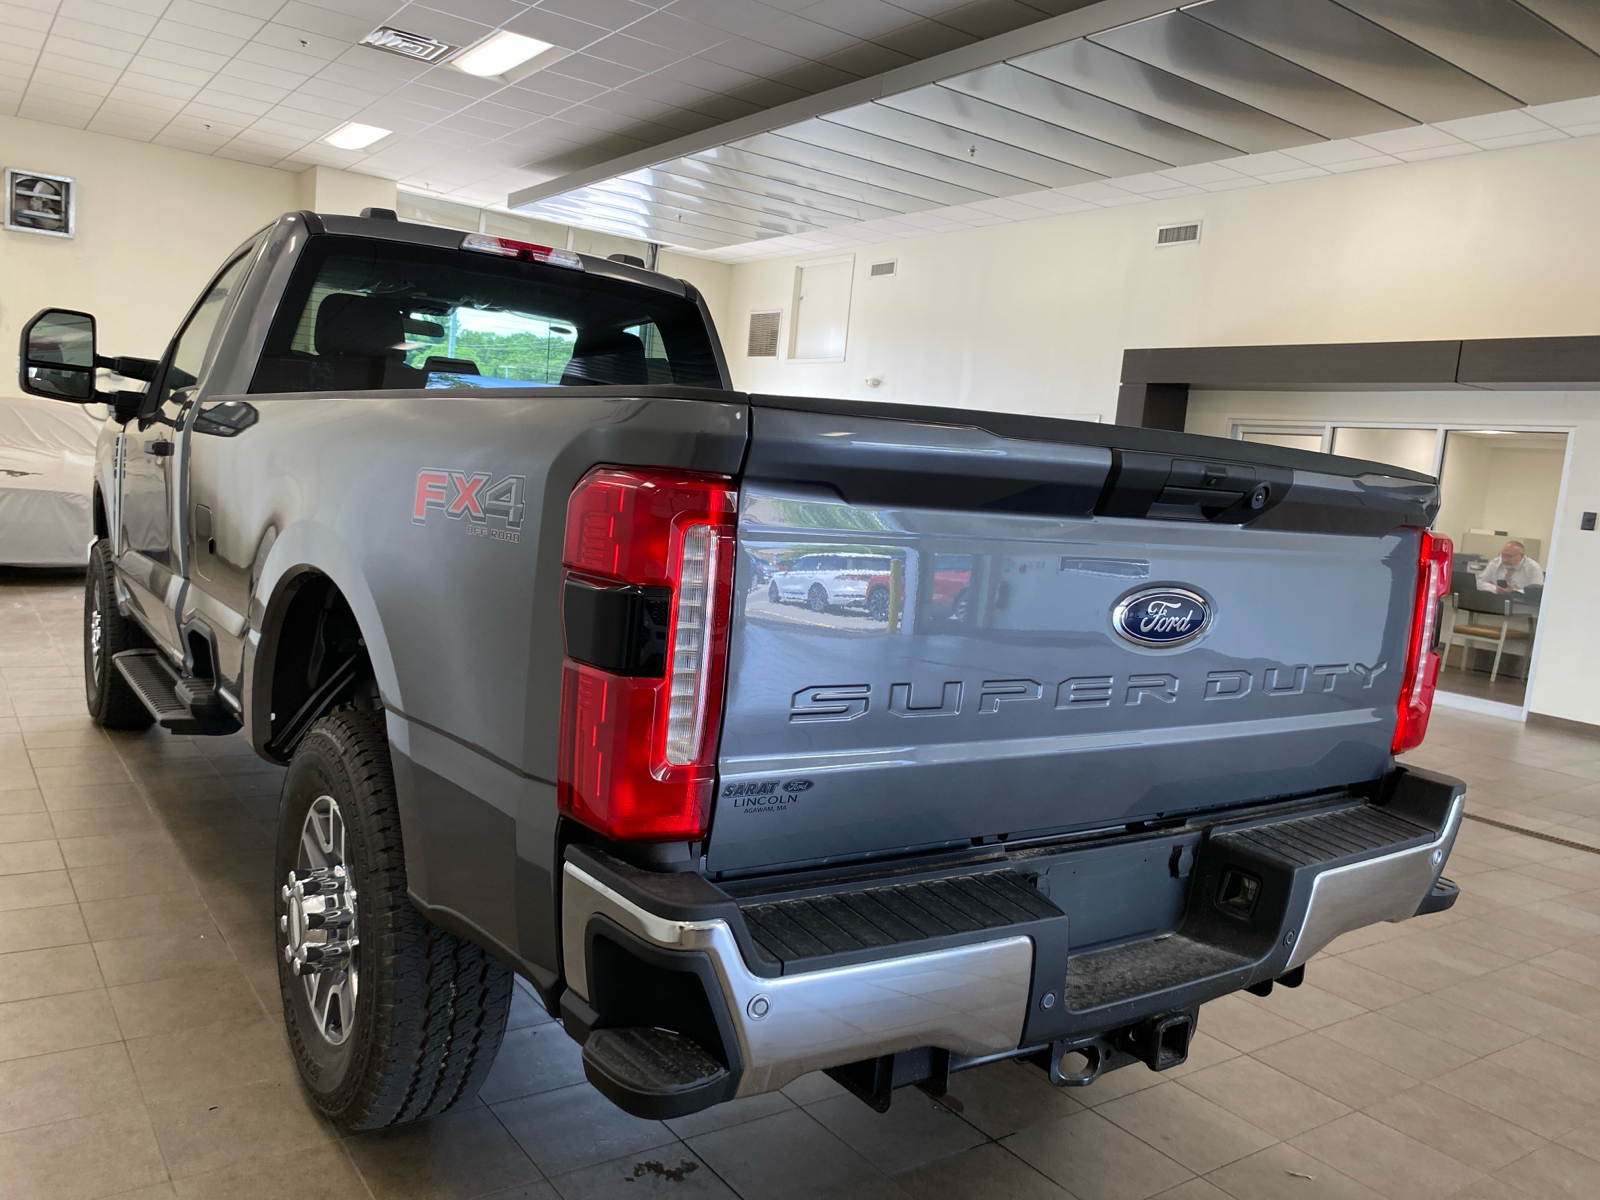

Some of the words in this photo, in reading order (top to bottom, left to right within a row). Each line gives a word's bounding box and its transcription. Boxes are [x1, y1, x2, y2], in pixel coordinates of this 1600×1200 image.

[411, 466, 527, 531] FX4
[466, 525, 488, 537] OFF
[490, 529, 521, 544] ROAD
[1139, 600, 1194, 633] Ford
[788, 673, 1180, 724] SUPER
[1203, 661, 1388, 701] DUTY
[721, 780, 780, 799] SARAT
[733, 794, 798, 808] LINCOLN
[743, 805, 775, 814] AGAWAM,
